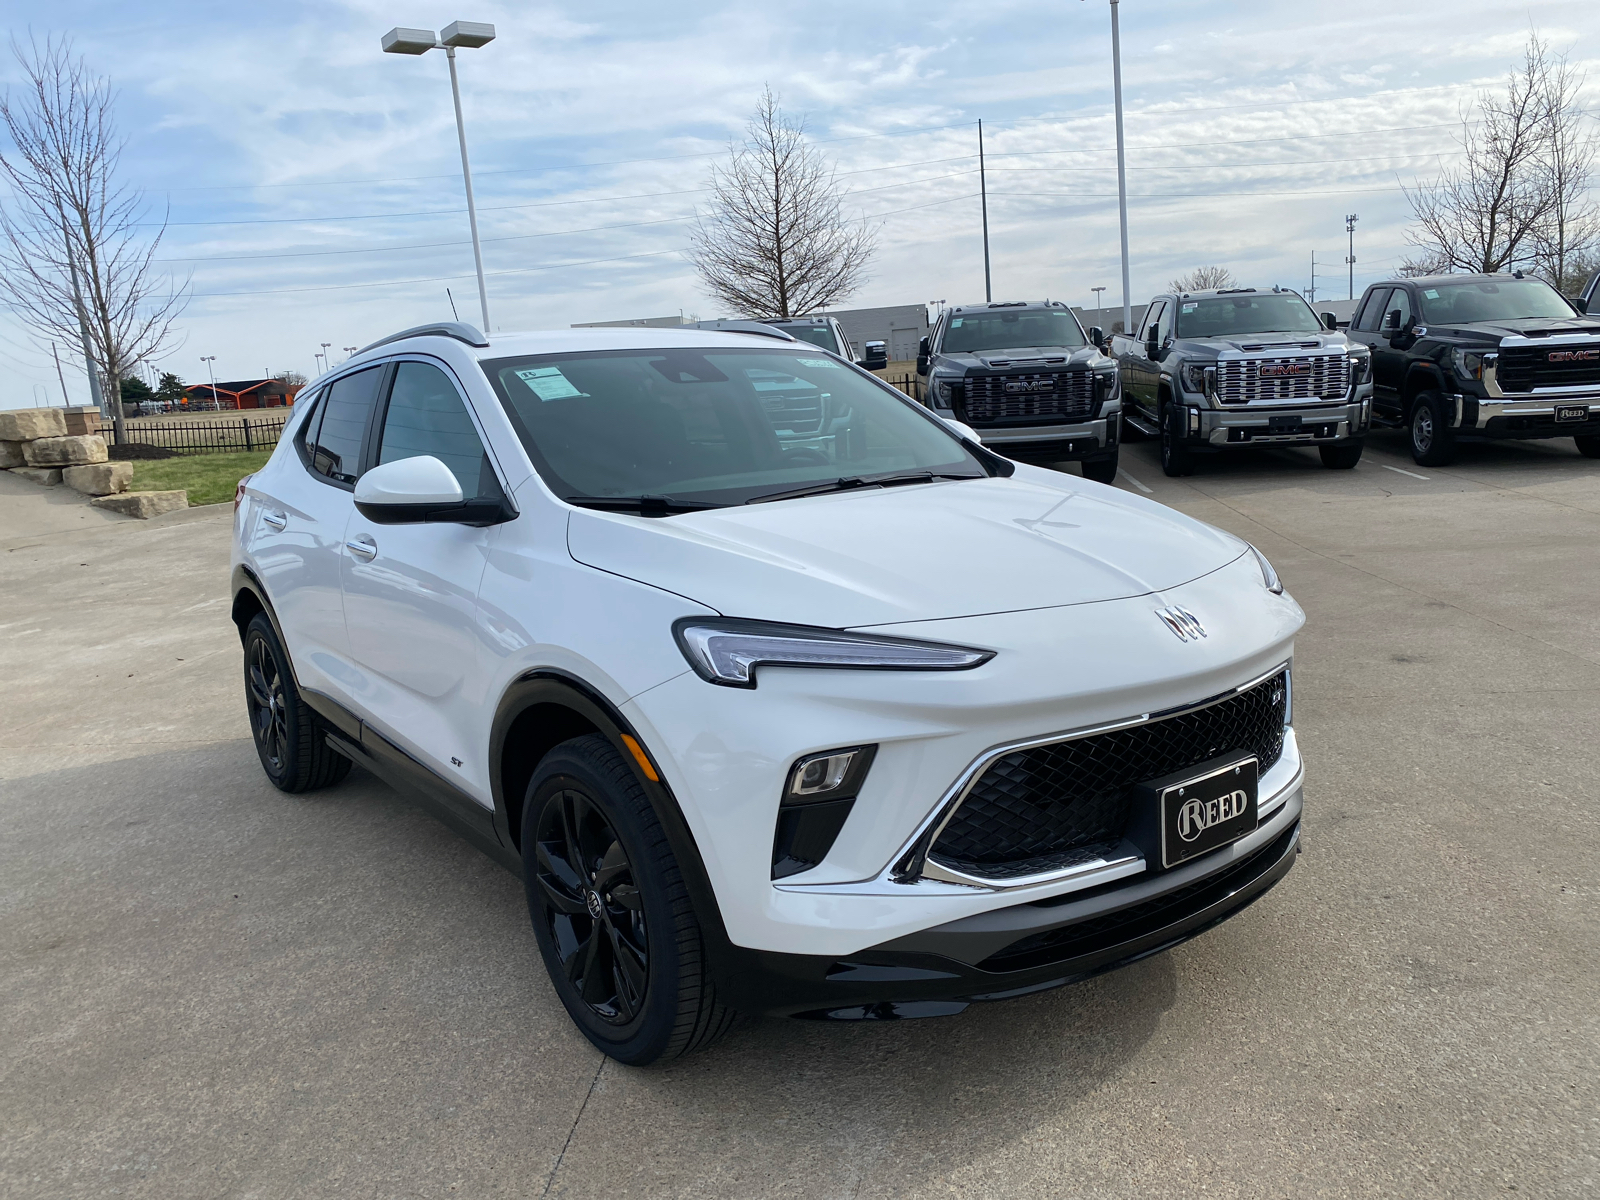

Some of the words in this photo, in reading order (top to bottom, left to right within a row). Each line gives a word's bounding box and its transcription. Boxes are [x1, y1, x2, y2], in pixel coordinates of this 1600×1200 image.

[1548, 350, 1600, 362] GMC
[1261, 364, 1310, 376] GMC
[1005, 380, 1054, 392] GMC
[1560, 409, 1585, 419] REED
[450, 756, 464, 767] ST
[1178, 789, 1248, 842] REED
